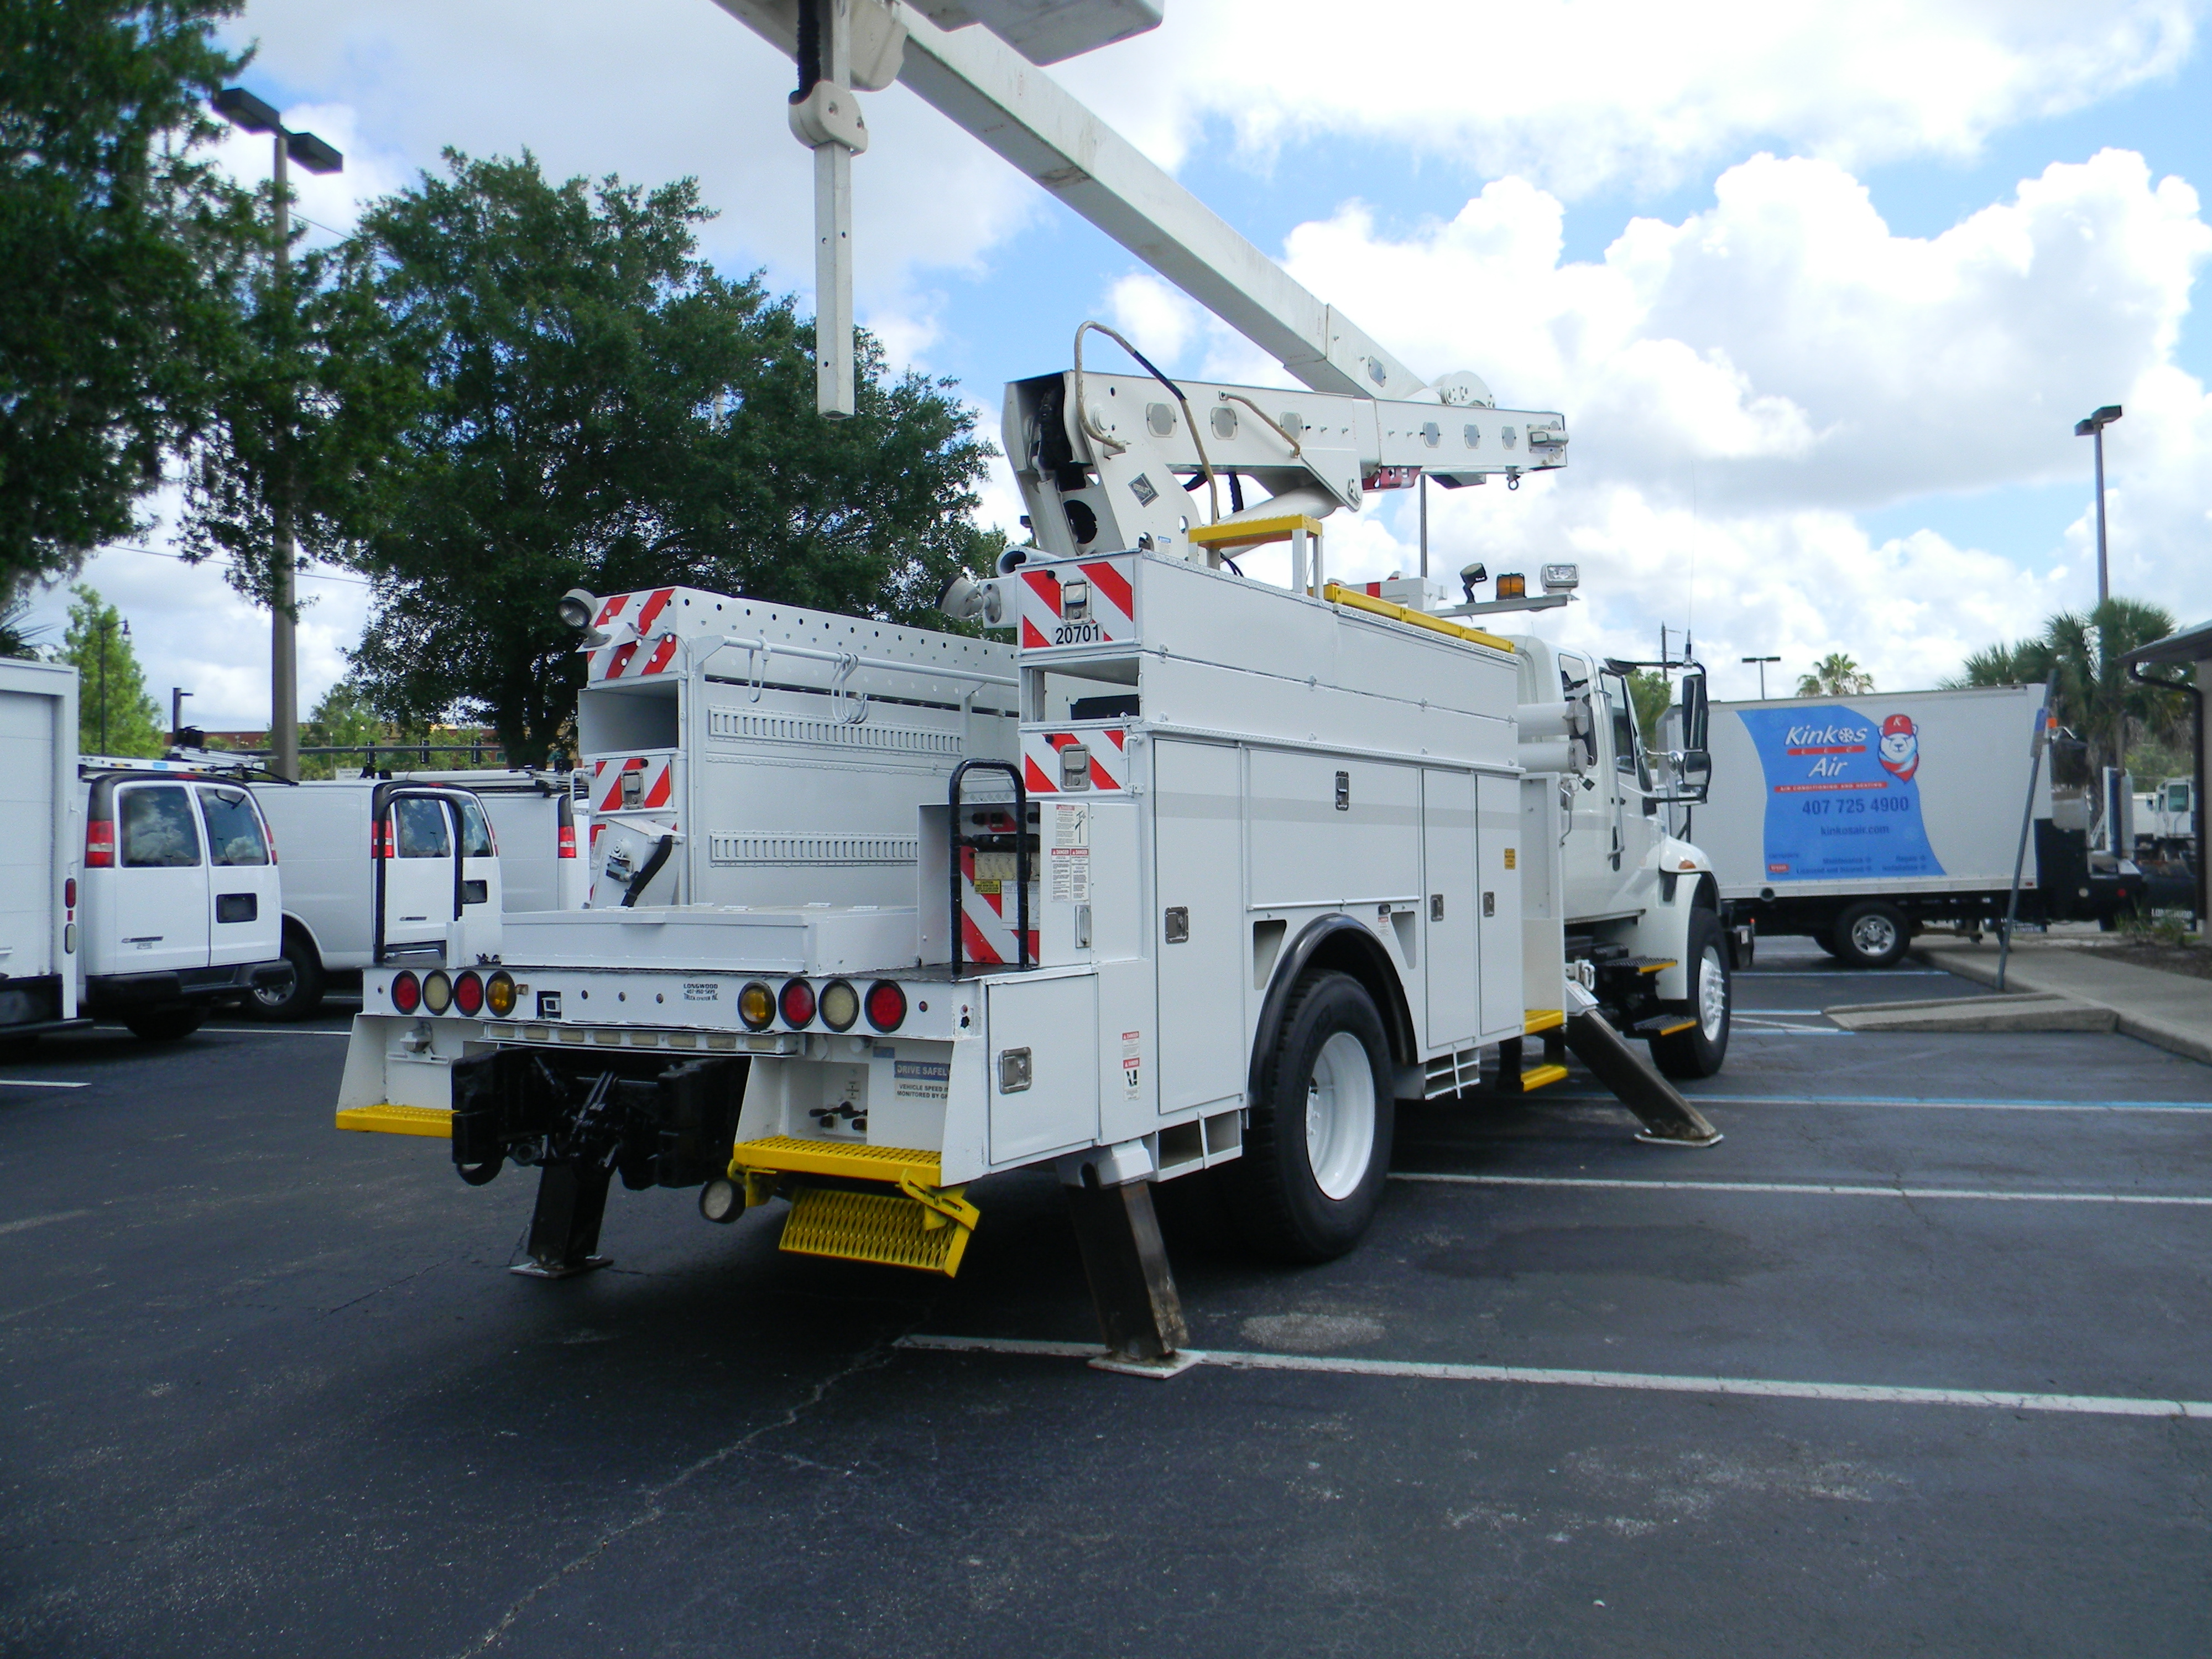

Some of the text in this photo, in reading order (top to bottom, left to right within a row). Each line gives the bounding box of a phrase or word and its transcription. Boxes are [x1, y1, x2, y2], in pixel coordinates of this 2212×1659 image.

[1055, 624, 1099, 645] 20701
[1808, 756, 1848, 778] Air
[1803, 796, 1909, 815] 407 725 4900
[1820, 825, 1890, 836] kinkosair.com
[897, 1065, 921, 1074] DRIVE
